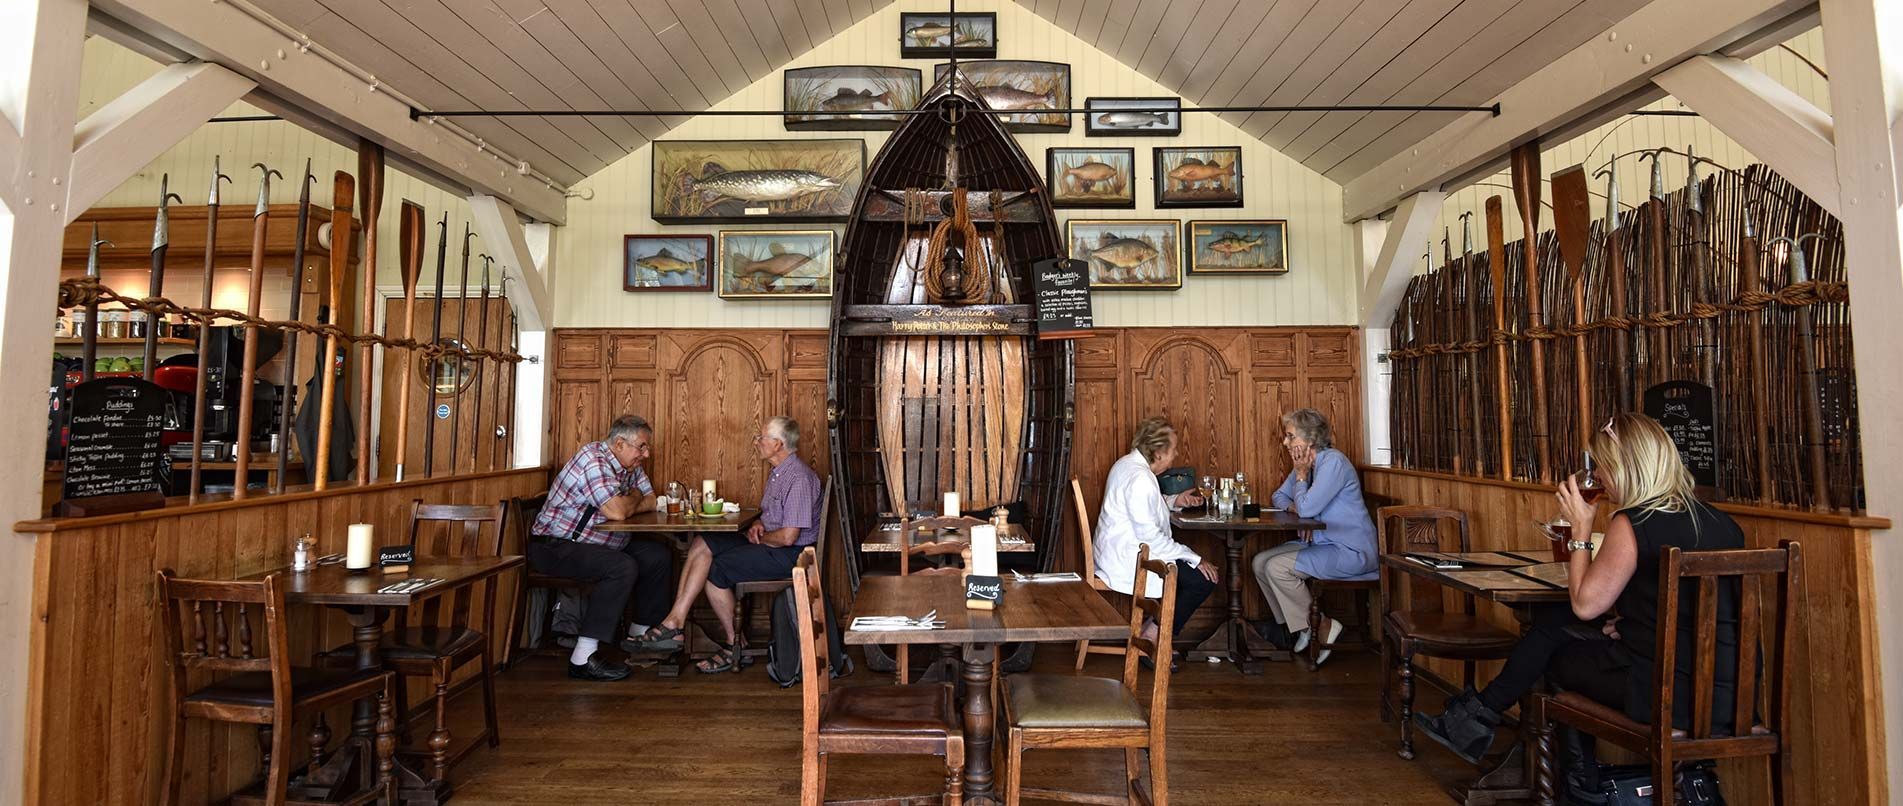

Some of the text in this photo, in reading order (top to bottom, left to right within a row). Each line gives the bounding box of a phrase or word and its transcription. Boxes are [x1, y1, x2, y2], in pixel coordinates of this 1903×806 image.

[913, 308, 932, 317] As
[935, 308, 985, 317] Featured
[892, 321, 913, 332] Harry
[913, 321, 930, 330] Potter
[939, 321, 950, 330] The
[992, 321, 1009, 330] Stone
[106, 400, 134, 414] Puddings
[1664, 402, 1687, 413] Specials
[73, 415, 101, 423] Chocolate
[66, 475, 89, 483] Chocolate
[381, 550, 411, 560] Reserved
[968, 582, 1000, 591] Reserved
